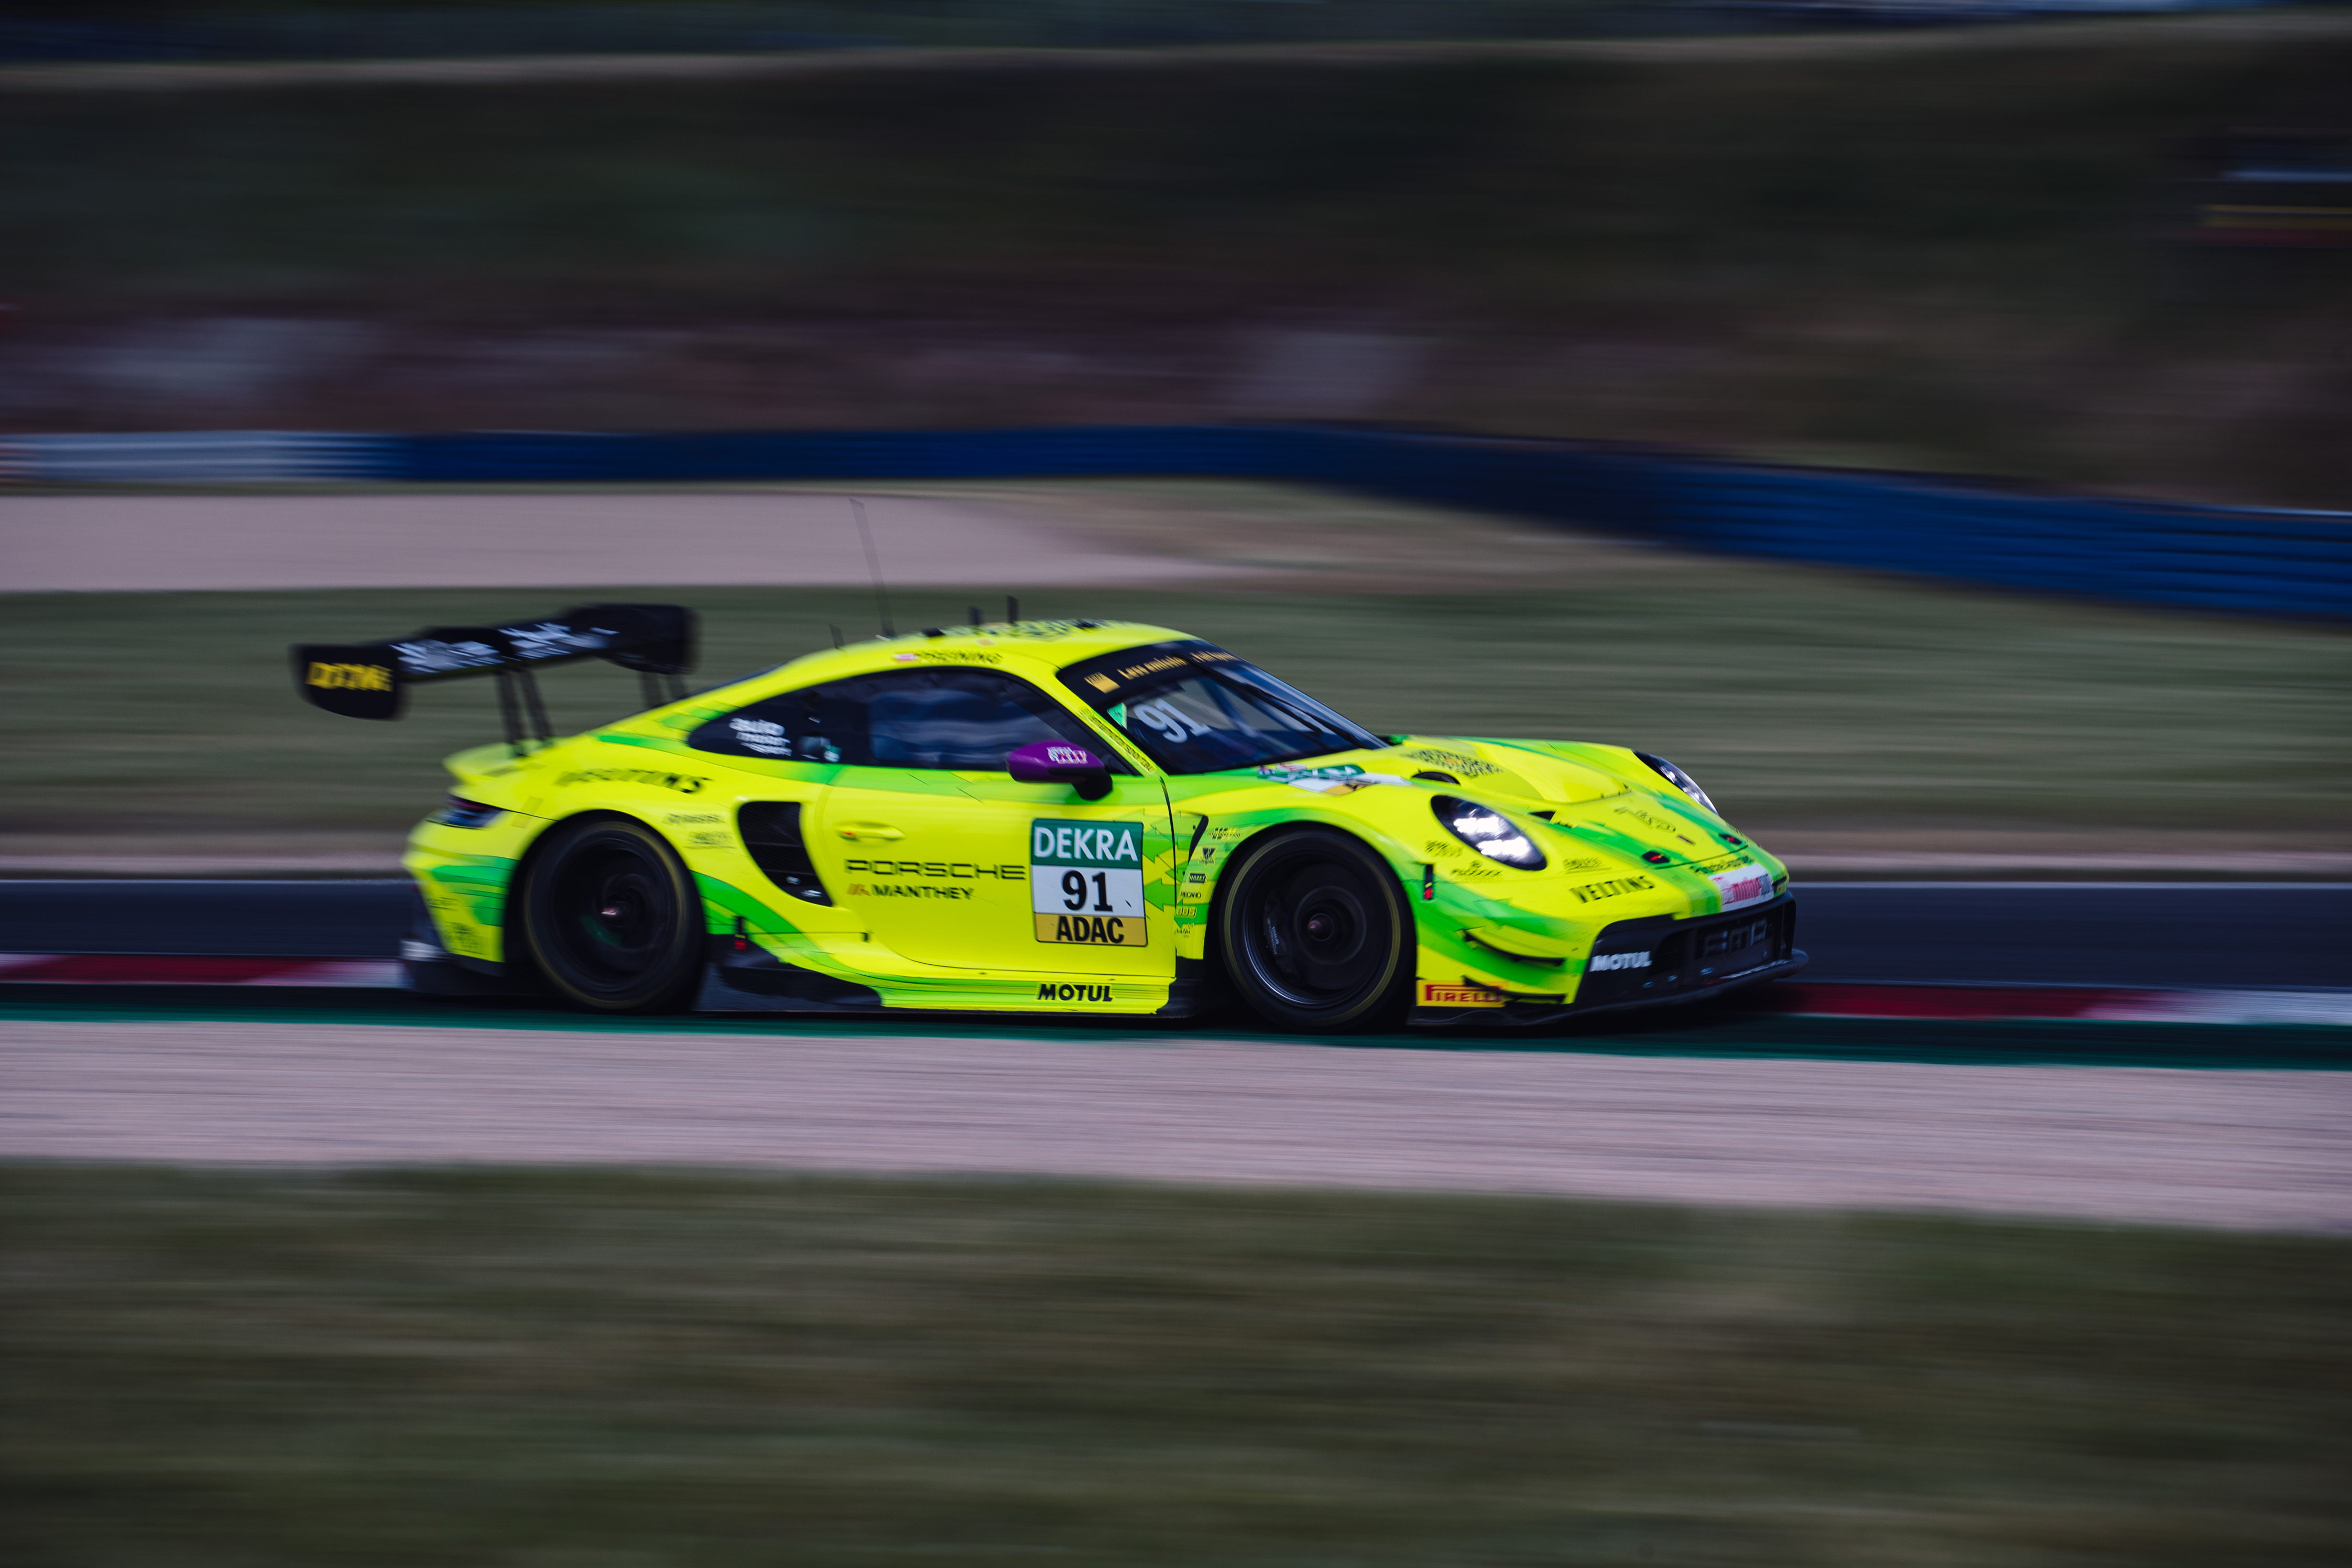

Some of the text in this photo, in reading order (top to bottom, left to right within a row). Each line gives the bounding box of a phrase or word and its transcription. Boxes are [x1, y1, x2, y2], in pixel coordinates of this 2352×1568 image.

[1134, 699, 1214, 743] 91
[1033, 826, 1139, 862] DEKRA
[844, 859, 1026, 880] PORSCHE
[872, 884, 974, 900] MANTHEY
[1061, 869, 1114, 912] 91
[1568, 876, 1656, 903] VELTINS
[1056, 915, 1125, 943] ADAC
[1589, 951, 1652, 972] MOTUL
[1037, 983, 1114, 1001] MOTUL
